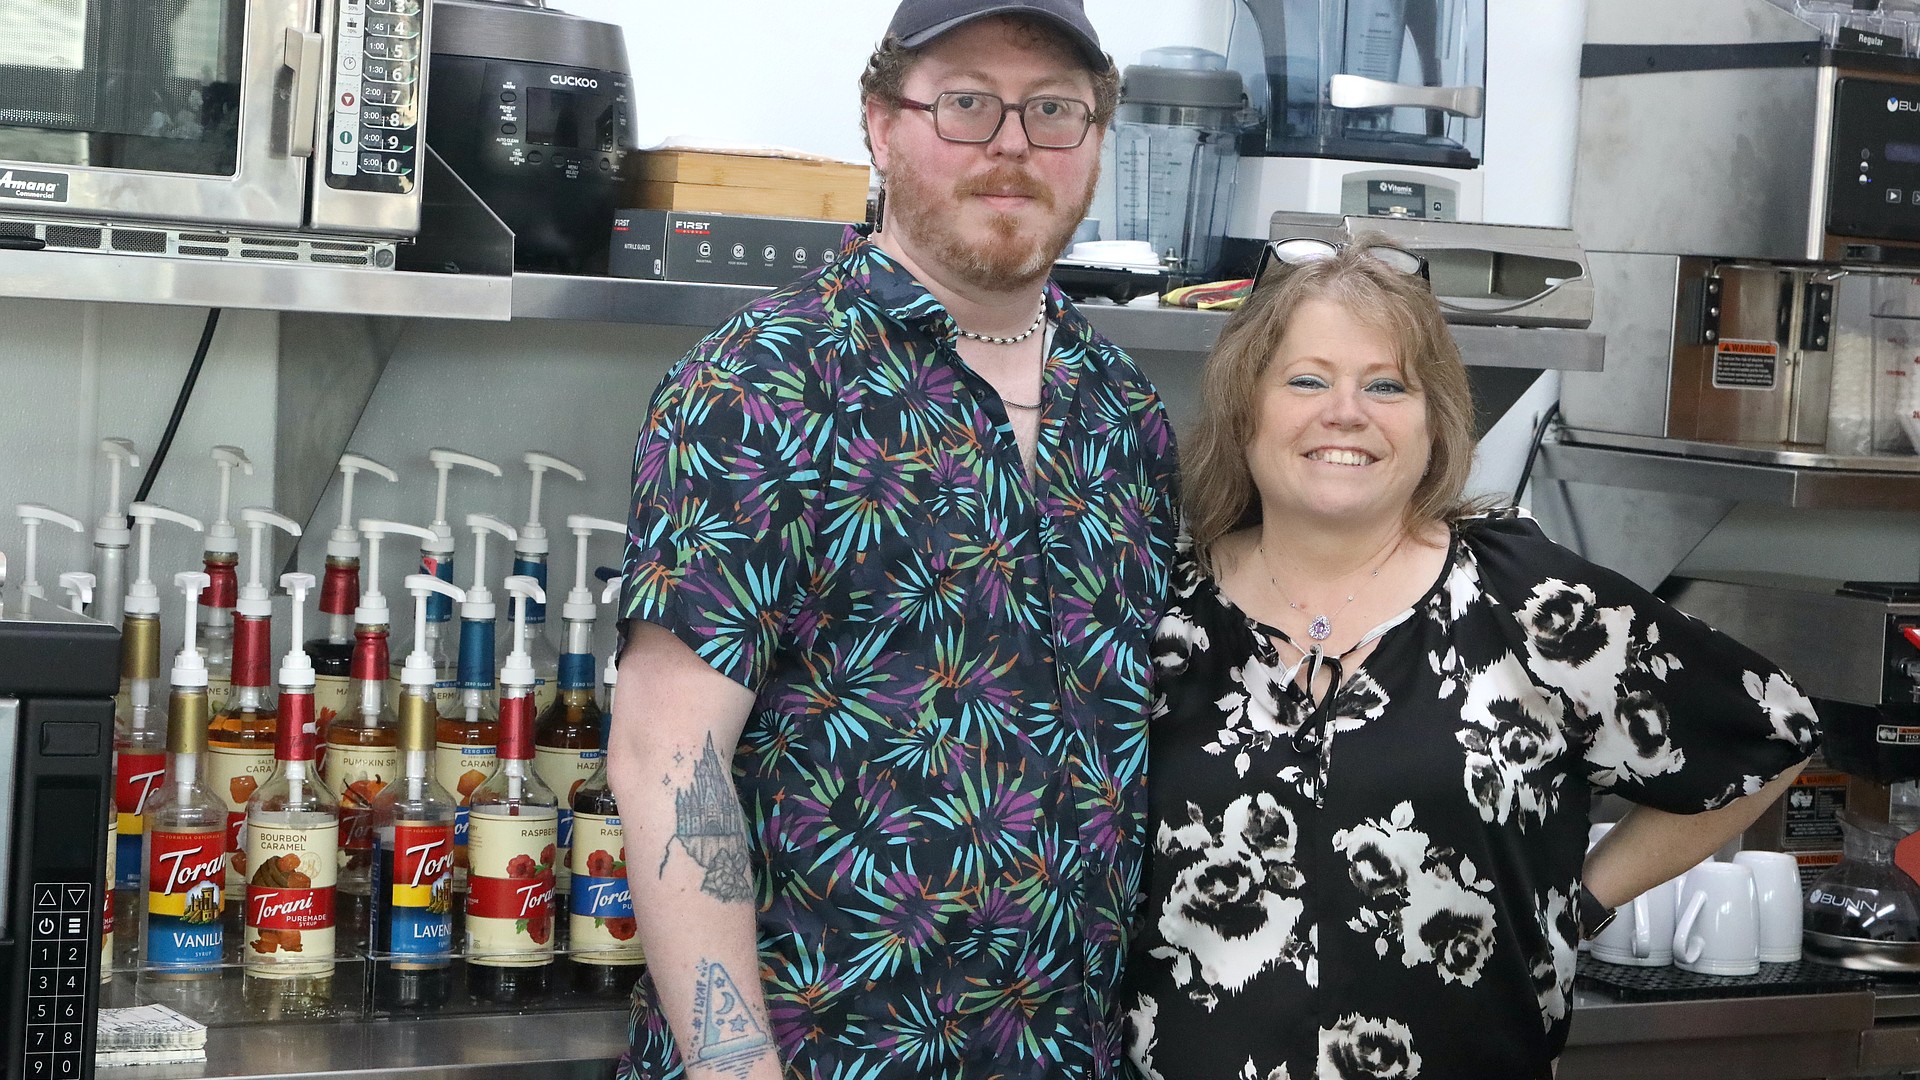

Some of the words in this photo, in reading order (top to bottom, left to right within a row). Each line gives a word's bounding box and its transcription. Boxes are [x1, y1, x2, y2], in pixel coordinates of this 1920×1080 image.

[372, 23, 384, 31] :45
[394, 22, 405, 35] 4
[1858, 33, 1885, 47] Regular
[369, 42, 385, 50] 1:00
[393, 44, 403, 58] 5
[368, 65, 384, 74] 1:30
[392, 68, 402, 82] 6
[549, 74, 598, 89] CUCKOO
[365, 87, 381, 96] 2:00
[391, 90, 401, 104] 7
[363, 111, 380, 120] 3:00
[389, 113, 400, 127] 8
[363, 134, 380, 142] 4:00
[388, 135, 399, 150] 9
[363, 158, 380, 166] 5:00
[387, 158, 398, 173] 0
[0, 170, 57, 192] Amana
[1387, 183, 1413, 193] Vitamix
[15, 190, 55, 199] Commercial
[1731, 343, 1771, 354] WARNING
[343, 757, 384, 767] PUMPKIN
[460, 759, 494, 769] CARAM
[260, 833, 307, 842] BOURBON
[260, 842, 306, 851] CARAMEL
[253, 891, 314, 925] Torani
[1820, 893, 1878, 912] BUNN
[286, 913, 327, 922] PUREMADE
[41, 948, 48, 961] 1
[68, 947, 78, 961] 2
[194, 950, 212, 958] SYRUP
[39, 976, 48, 989] 3
[66, 975, 76, 989] 4
[37, 1004, 46, 1017] 5
[65, 1004, 74, 1017] 6
[36, 1032, 45, 1045] 7
[64, 1031, 73, 1045] 8
[34, 1061, 43, 1074] 9
[62, 1060, 71, 1073] 0
